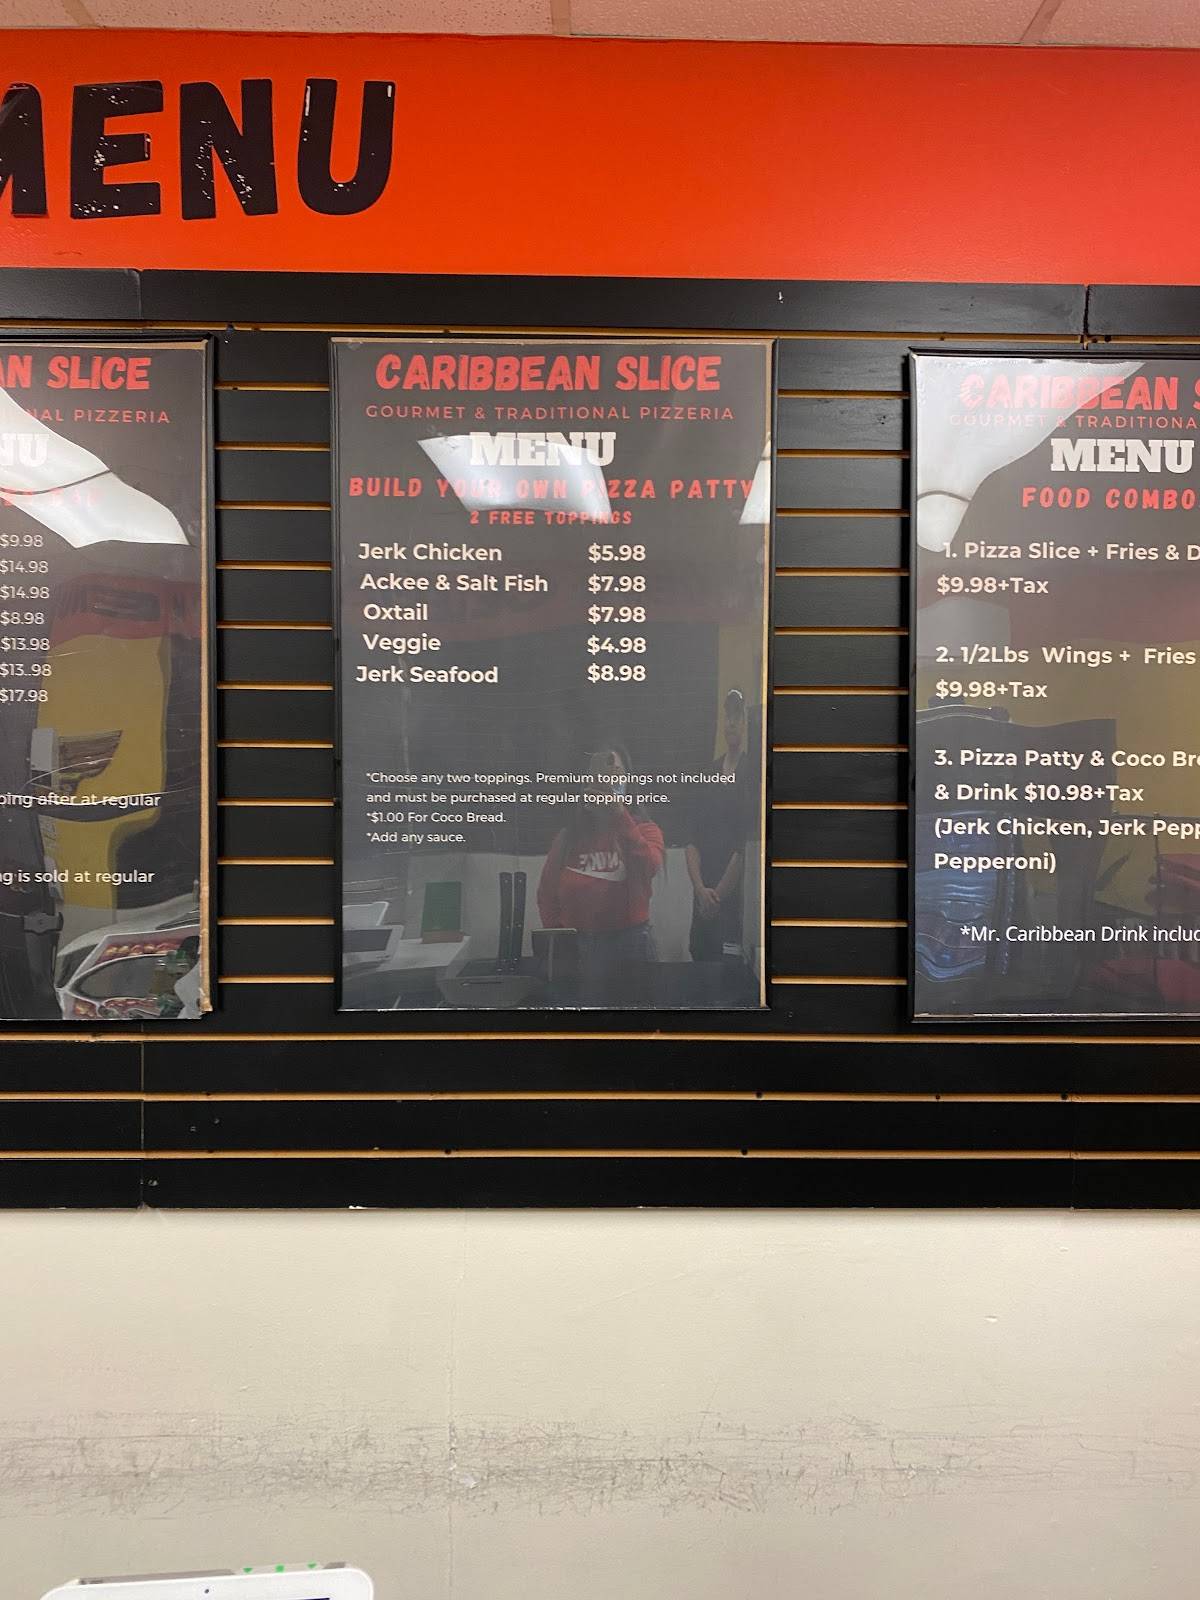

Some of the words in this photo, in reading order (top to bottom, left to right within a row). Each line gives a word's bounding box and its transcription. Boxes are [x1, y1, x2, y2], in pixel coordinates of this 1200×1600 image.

[47, 356, 152, 390] SLICE
[375, 354, 600, 391] CARIBBEAN
[615, 355, 722, 391] SLICE
[960, 374, 1179, 411] CARIBBEAN
[74, 409, 170, 423] PIZZERIA
[366, 405, 465, 418] GOURMET
[474, 406, 486, 419] &
[495, 406, 630, 420] TRADITIONAL
[640, 407, 734, 421] PIZZERIA
[950, 414, 1048, 427] GOURMET
[1075, 416, 1198, 429] TRADITIONA
[469, 431, 617, 467] MENU
[1050, 438, 1195, 474] MENU
[349, 477, 422, 498] BUILD
[436, 478, 502, 499] YOUR
[516, 478, 568, 499] OWN
[581, 479, 656, 499] PIZZA
[670, 479, 756, 499] PATTY
[1022, 487, 1091, 509] FOOD
[1106, 488, 1200, 510] COMBO
[470, 510, 480, 525] 2
[488, 510, 535, 525] FREE
[545, 510, 632, 525] TOPPINGS
[0, 534, 43, 549] $9.98
[943, 542, 957, 559] 1.
[965, 541, 1022, 560] Pizza
[1028, 541, 1081, 560] Slice
[1088, 547, 1099, 558] +
[1106, 542, 1159, 561] Fries
[1165, 544, 1180, 561] &
[358, 542, 406, 561] Jerk
[413, 542, 502, 562] Chicken
[588, 543, 646, 563] $5.98
[0, 560, 49, 574] $14.98
[0, 585, 50, 600] $14.98
[360, 574, 430, 592] Ackee
[435, 574, 450, 592] &
[456, 574, 498, 592] Salt
[504, 573, 549, 593] Fish
[588, 574, 646, 594] $7.98
[936, 575, 1049, 596] $9.98+Tax
[0, 610, 45, 626] $8.98
[363, 603, 428, 622] Oxtail
[588, 604, 646, 624] $7.98
[1, 636, 50, 652] $13.98
[362, 633, 442, 656] Veggie
[587, 635, 646, 655] $4.98
[935, 646, 954, 663] 2.
[960, 643, 1029, 666] 1/2Lbs
[1042, 645, 1113, 668] Wings
[1119, 650, 1131, 661] +
[1144, 646, 1196, 665] Fries
[356, 664, 405, 683] Jerk
[410, 664, 499, 684] Seafood
[587, 663, 646, 683] $8.98
[0, 688, 48, 703] $17.98
[935, 679, 1048, 700] $9.98+Tax
[934, 749, 953, 766] 3.
[960, 748, 1018, 766] Pizza
[1025, 749, 1084, 770] Patty
[1090, 750, 1105, 767] &
[1111, 750, 1166, 767] Coco
[421, 774, 444, 787] any
[447, 774, 471, 785] two
[474, 772, 533, 787] toppings.
[536, 772, 594, 785] Premium
[597, 773, 653, 787] toppings
[656, 774, 678, 784] not
[680, 772, 736, 784] included
[37, 792, 75, 805] after
[81, 793, 98, 805] at
[103, 793, 161, 808] regular
[366, 792, 391, 804] and
[395, 793, 427, 804] must
[431, 792, 447, 804] be
[450, 792, 517, 806] purchased
[520, 793, 533, 804] at
[536, 792, 580, 806] regular
[583, 792, 634, 806] topping
[636, 792, 671, 806] price.
[934, 784, 950, 801] &
[956, 783, 1018, 801] Drink
[1024, 782, 1144, 803] $10.98+Tax
[407, 812, 428, 823] For
[431, 812, 463, 823] Coco
[466, 812, 506, 823] Bread.
[934, 818, 990, 839] (Jerk
[996, 818, 1092, 839] Chicken,
[1098, 819, 1146, 837] Jerk
[401, 834, 424, 846] any
[427, 834, 466, 844] sauce.
[934, 852, 1057, 873] Pepperoni)
[18, 869, 30, 883] is
[34, 869, 69, 883] sold
[74, 871, 91, 883] at
[96, 869, 155, 885] regular
[1005, 925, 1096, 942] Caribbean
[1101, 925, 1148, 942] Drink
